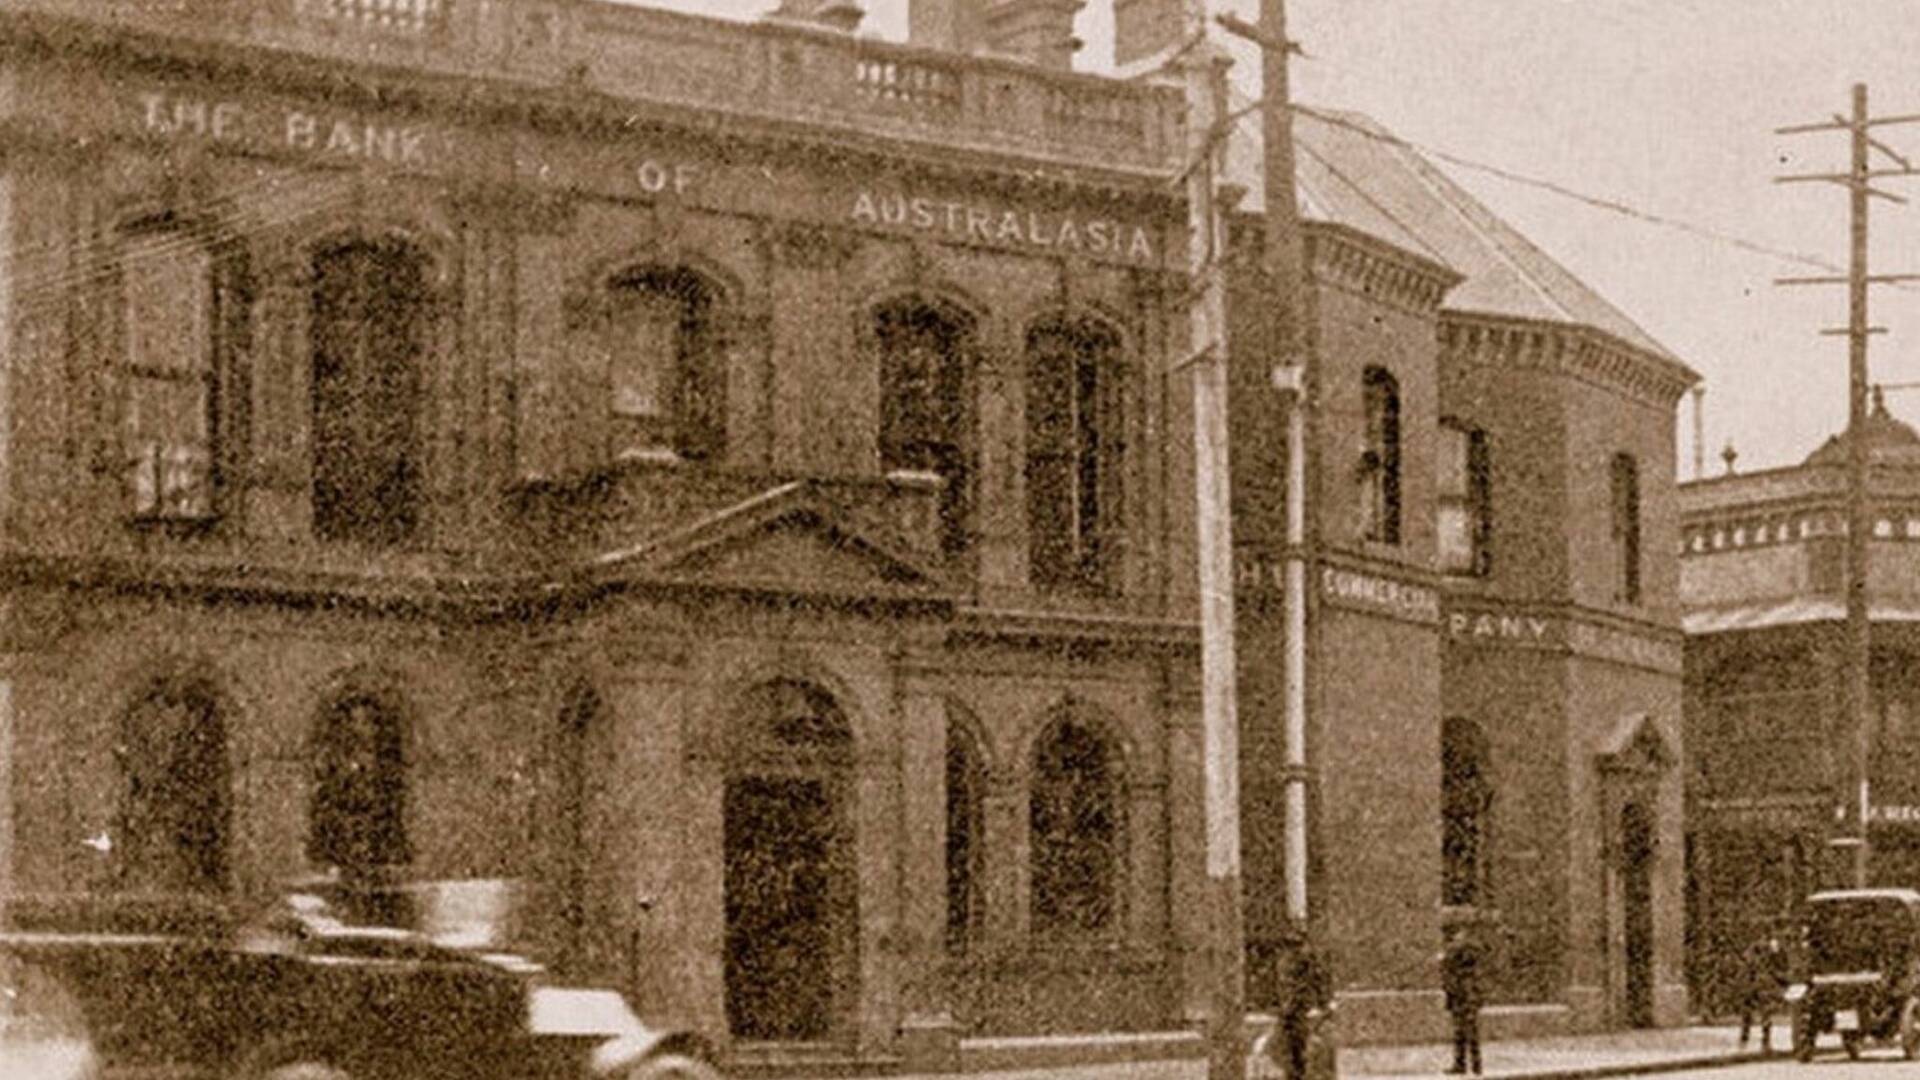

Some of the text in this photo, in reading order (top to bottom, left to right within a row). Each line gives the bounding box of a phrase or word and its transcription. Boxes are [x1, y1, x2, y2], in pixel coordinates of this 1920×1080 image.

[143, 94, 1151, 257] THE BANK OF AUSTRALASIA
